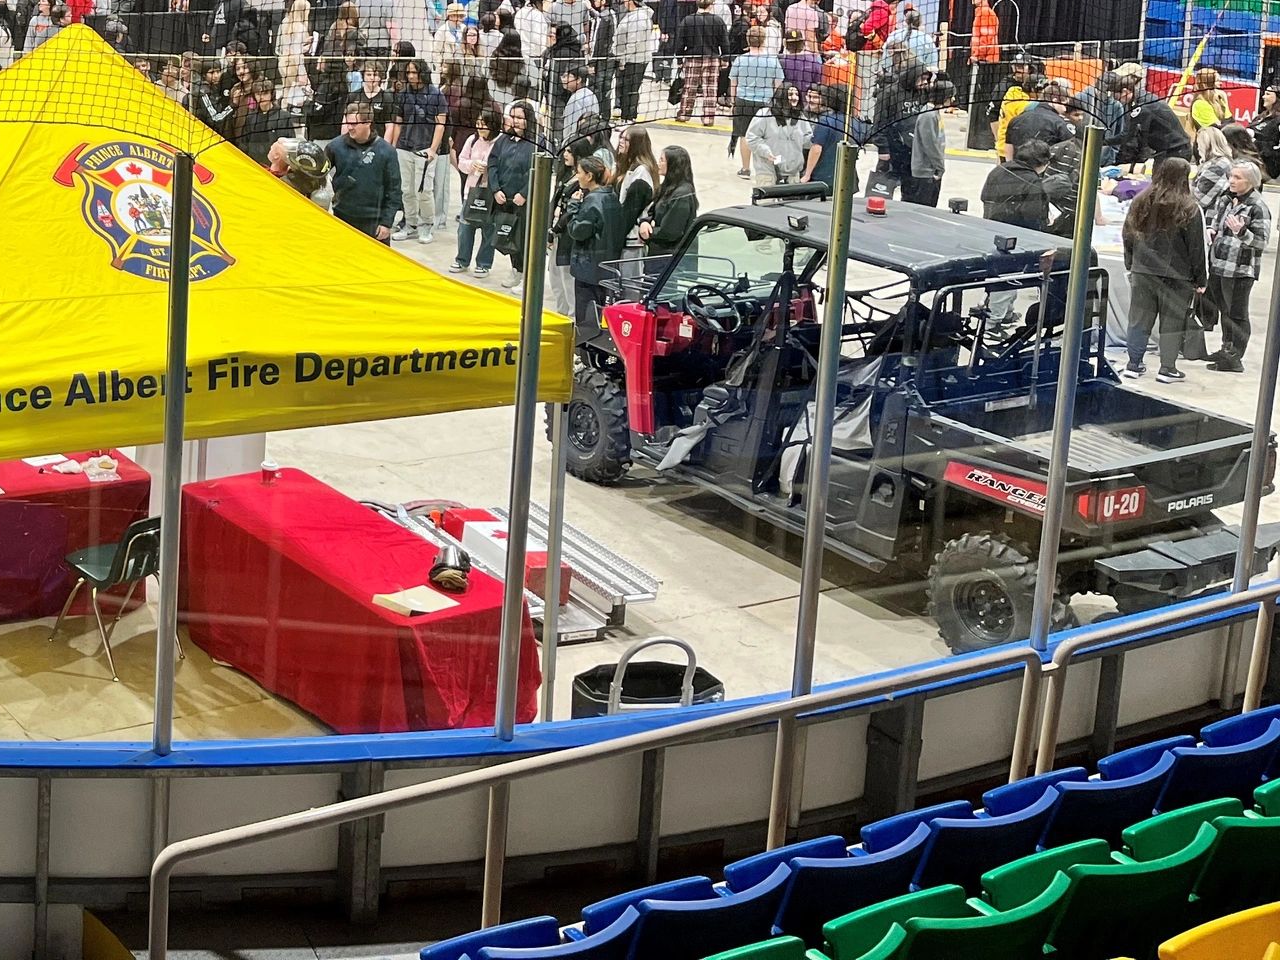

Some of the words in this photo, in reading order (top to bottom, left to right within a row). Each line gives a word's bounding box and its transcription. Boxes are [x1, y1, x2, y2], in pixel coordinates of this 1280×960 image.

[84, 144, 124, 170] PRINCE
[129, 144, 175, 170] ALBERT
[150, 247, 168, 257] EST.
[207, 356, 280, 391] Fire
[295, 342, 517, 386] Department
[1103, 492, 1140, 518] U-20
[1168, 494, 1214, 513] POLARIS
